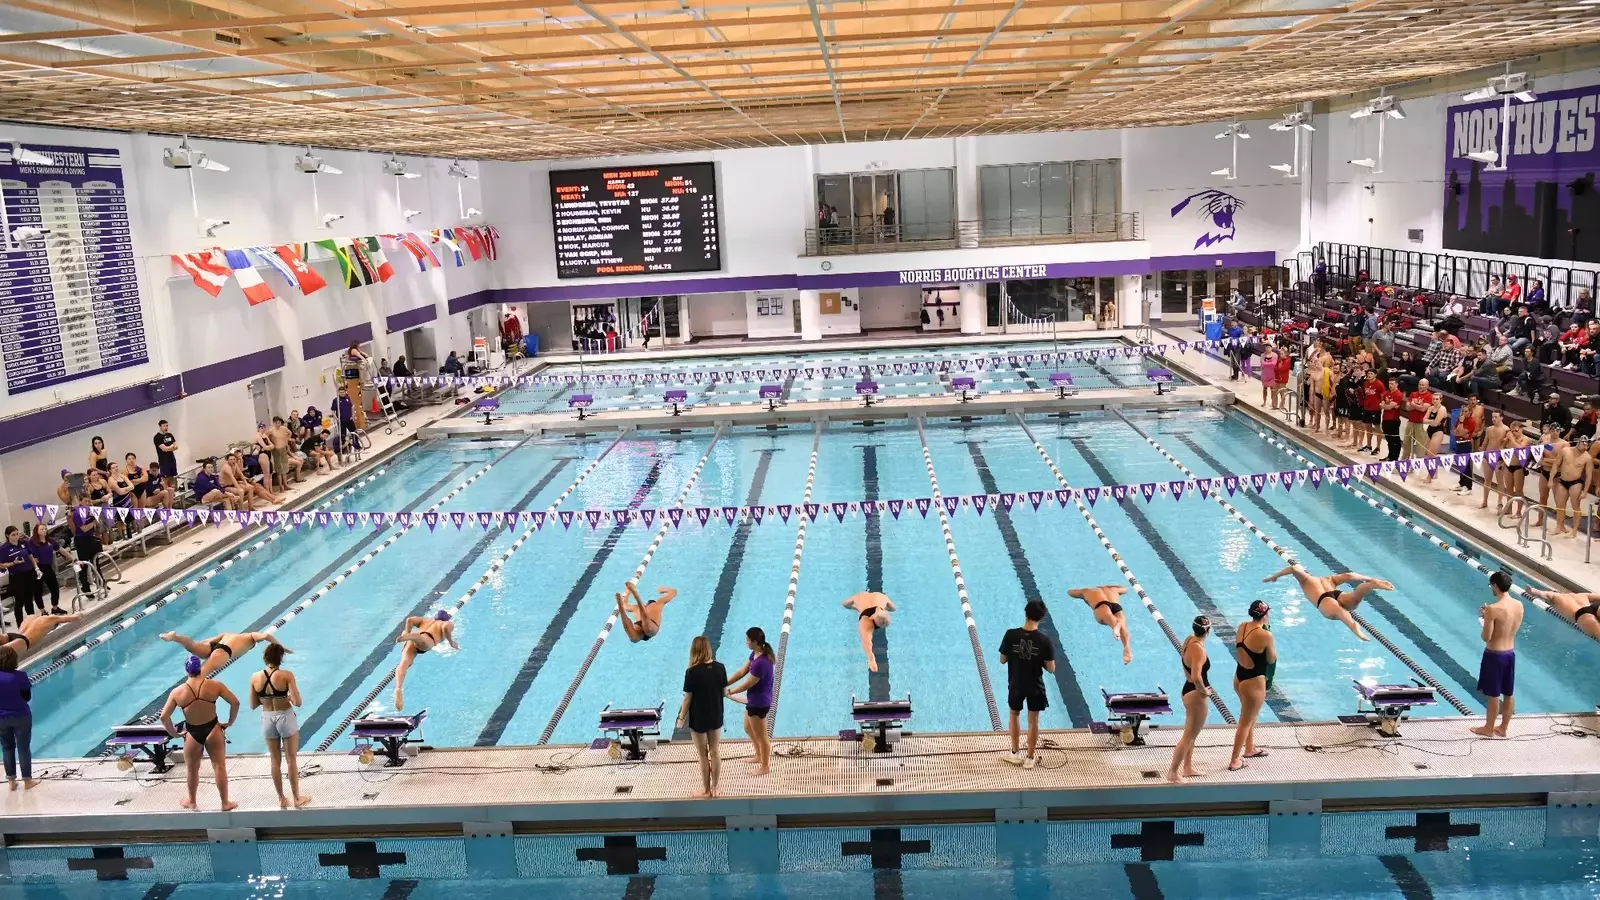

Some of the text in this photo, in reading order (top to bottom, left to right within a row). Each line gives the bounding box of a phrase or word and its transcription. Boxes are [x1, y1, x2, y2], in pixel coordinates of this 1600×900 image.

[1453, 95, 1600, 158] NORTHWES
[900, 265, 1047, 283] NORRIS AQUATICS CENTER
[1488, 452, 1496, 463] N
[1518, 449, 1526, 460] N
[1428, 459, 1436, 469] N
[1458, 456, 1467, 466] N
[1369, 465, 1378, 476] N
[1399, 462, 1407, 473] N
[1312, 471, 1320, 482] N
[1341, 468, 1349, 478] N
[1227, 478, 1235, 489] N
[1255, 476, 1263, 487] N
[1284, 474, 1291, 484] N
[1173, 483, 1181, 493] N
[1201, 480, 1209, 490] N
[1088, 490, 1096, 500] N
[1116, 488, 1124, 498] N
[1144, 486, 1152, 496] N
[1004, 495, 1012, 505] N
[1032, 493, 1040, 504] N
[1059, 492, 1067, 502] N
[892, 502, 900, 513] N
[919, 501, 927, 512] N
[947, 499, 955, 510] N
[976, 497, 984, 508] N
[36, 507, 43, 517] N
[79, 508, 87, 518] N
[754, 508, 762, 518] N
[781, 506, 788, 517] N
[808, 505, 816, 515] N
[836, 504, 844, 514] N
[864, 503, 872, 514] N
[106, 509, 114, 519] N
[134, 510, 141, 520] N
[160, 510, 167, 520] N
[187, 511, 194, 521] N
[214, 512, 220, 522] N
[240, 512, 247, 523] N
[267, 513, 274, 524] N
[293, 513, 301, 523] N
[320, 514, 328, 524] N
[347, 514, 354, 524] N
[374, 514, 381, 524] N
[401, 514, 408, 524] N
[428, 514, 435, 524] N
[454, 514, 461, 524] N
[481, 514, 488, 524] N
[508, 514, 515, 524] N
[535, 513, 543, 524] N
[563, 513, 570, 524] N
[590, 512, 597, 523] N
[617, 512, 624, 522] N
[644, 512, 652, 521] N
[672, 510, 680, 521] N
[700, 510, 707, 520] N
[727, 509, 734, 519] N
